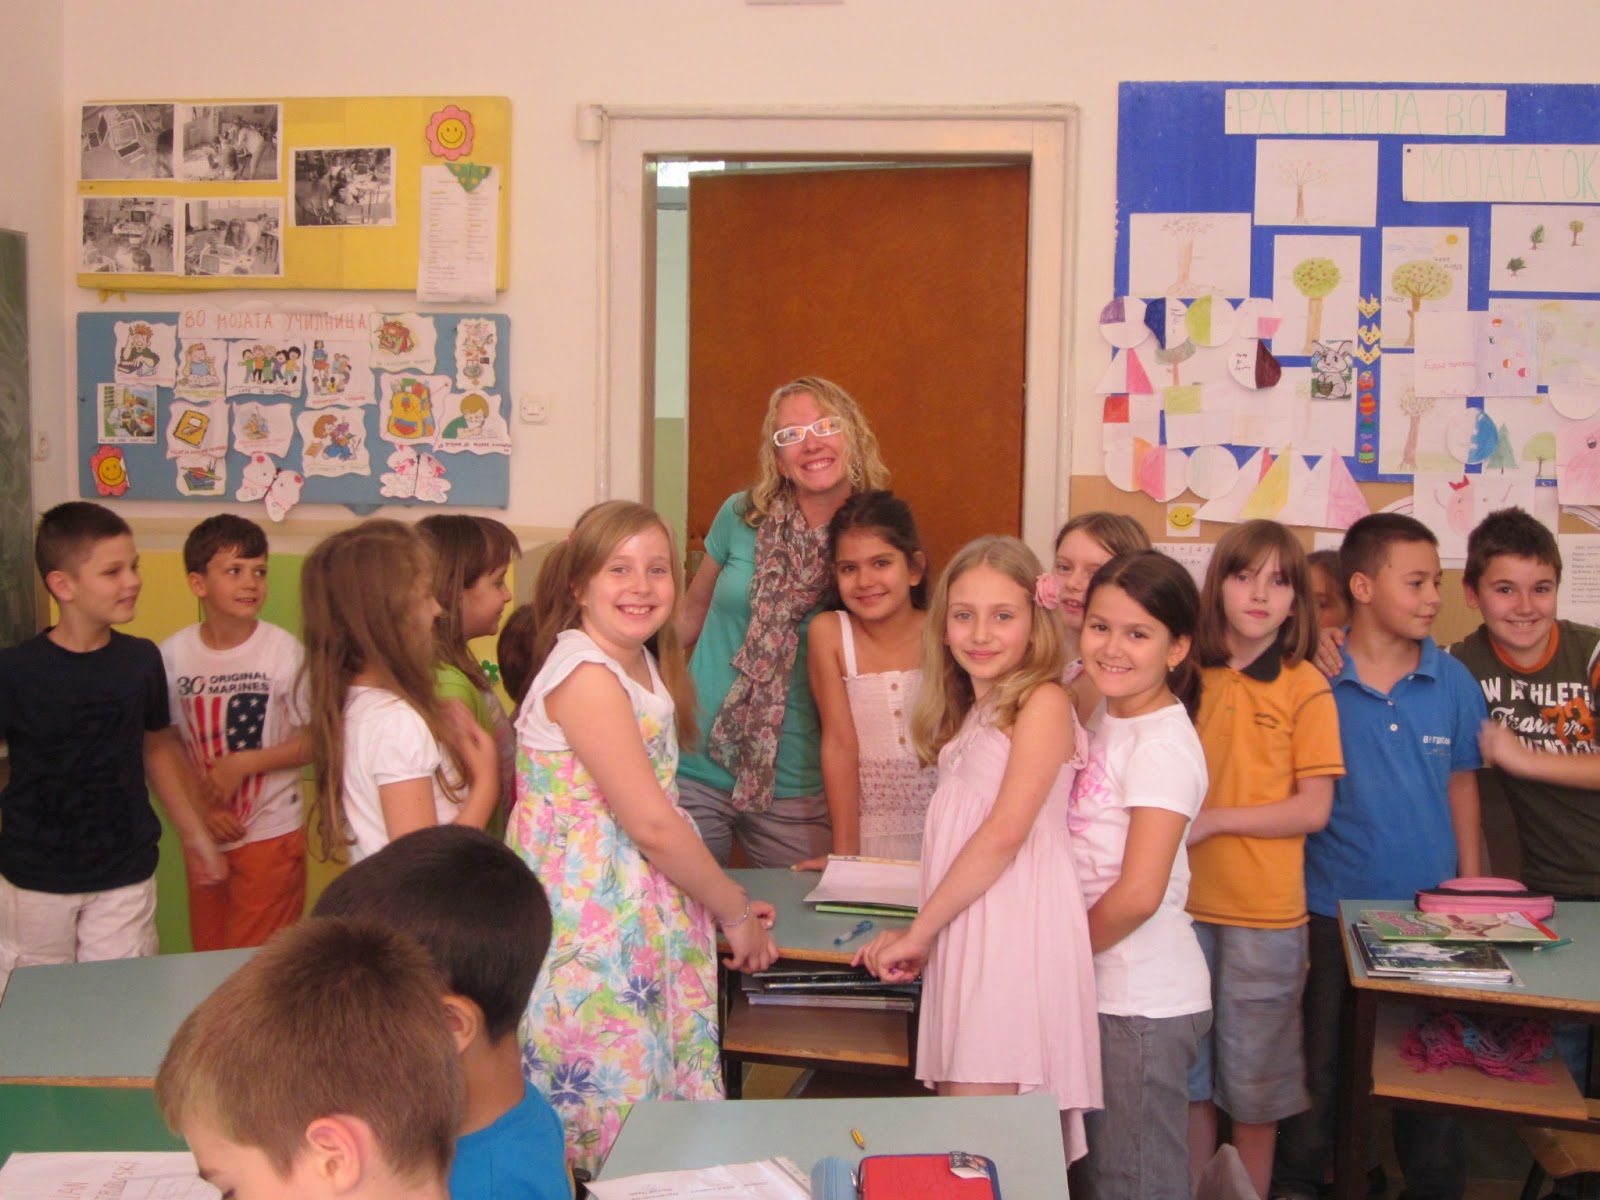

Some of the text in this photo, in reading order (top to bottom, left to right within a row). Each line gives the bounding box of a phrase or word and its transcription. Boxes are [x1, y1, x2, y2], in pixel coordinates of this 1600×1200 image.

[1236, 90, 1488, 135] РАСТЕНИЈА ВО
[1422, 148, 1547, 200] МОЈАТА
[184, 310, 206, 328] ВО
[217, 312, 273, 331] МОЈАТА
[177, 672, 271, 696] 30 ORIGINAL
[207, 682, 270, 694] MARINES
